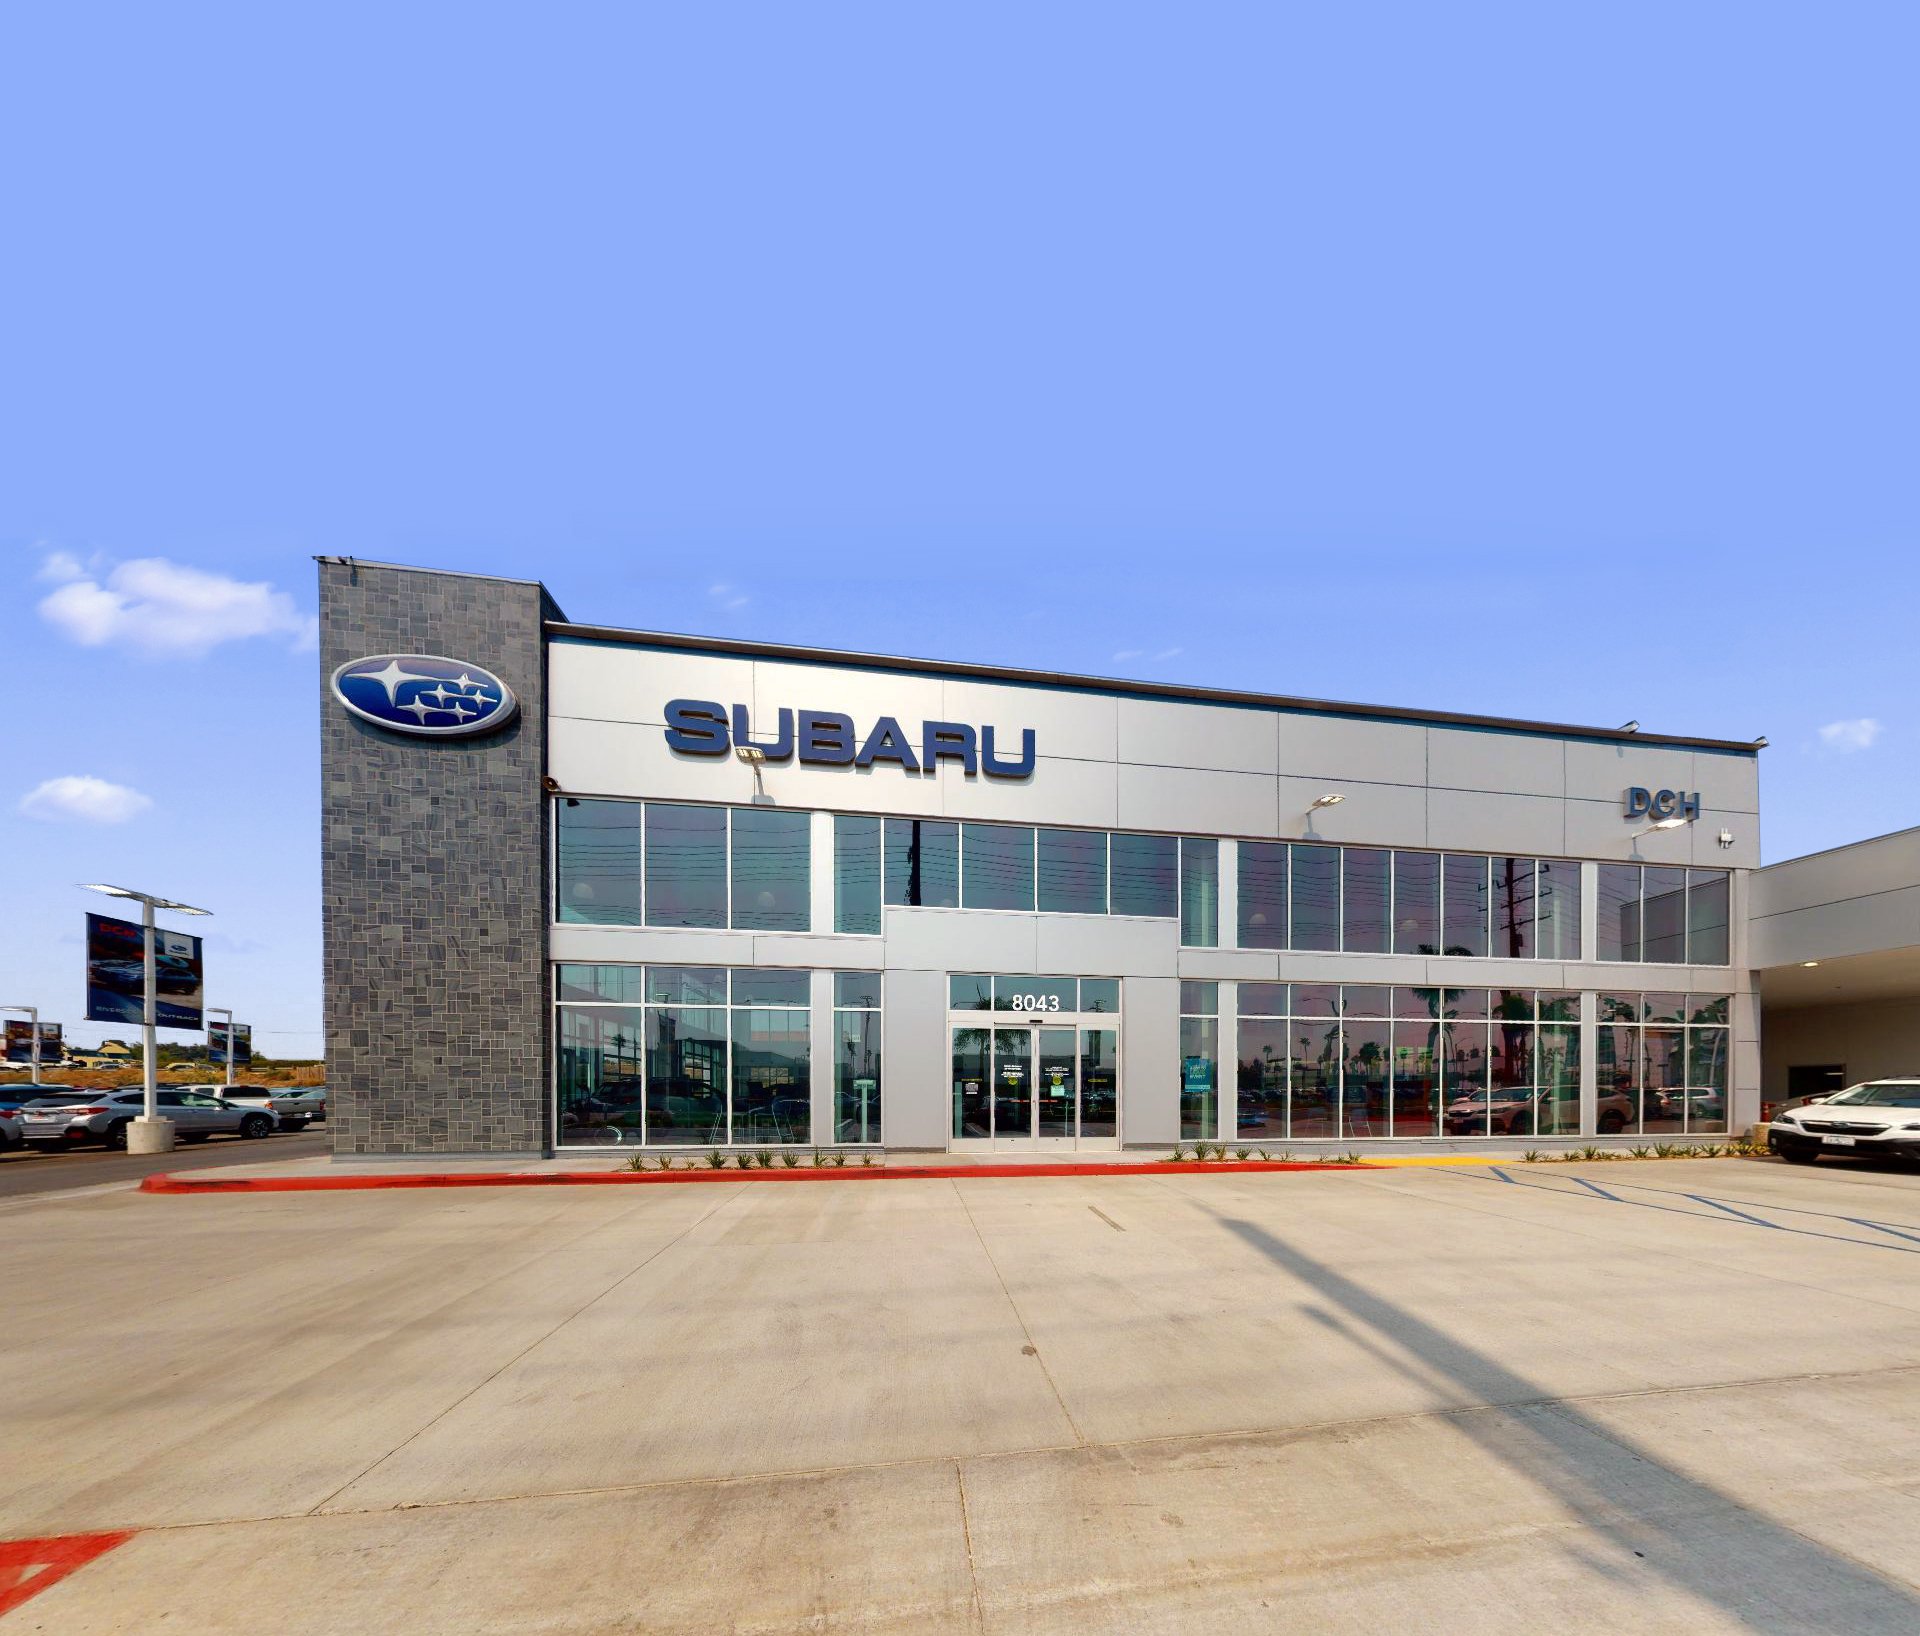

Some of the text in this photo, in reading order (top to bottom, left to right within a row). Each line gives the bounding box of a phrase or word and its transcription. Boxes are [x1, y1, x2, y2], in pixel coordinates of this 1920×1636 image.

[664, 699, 1036, 779] SUBARU
[1624, 786, 1700, 820] DCH
[1012, 994, 1060, 1012] 8043
